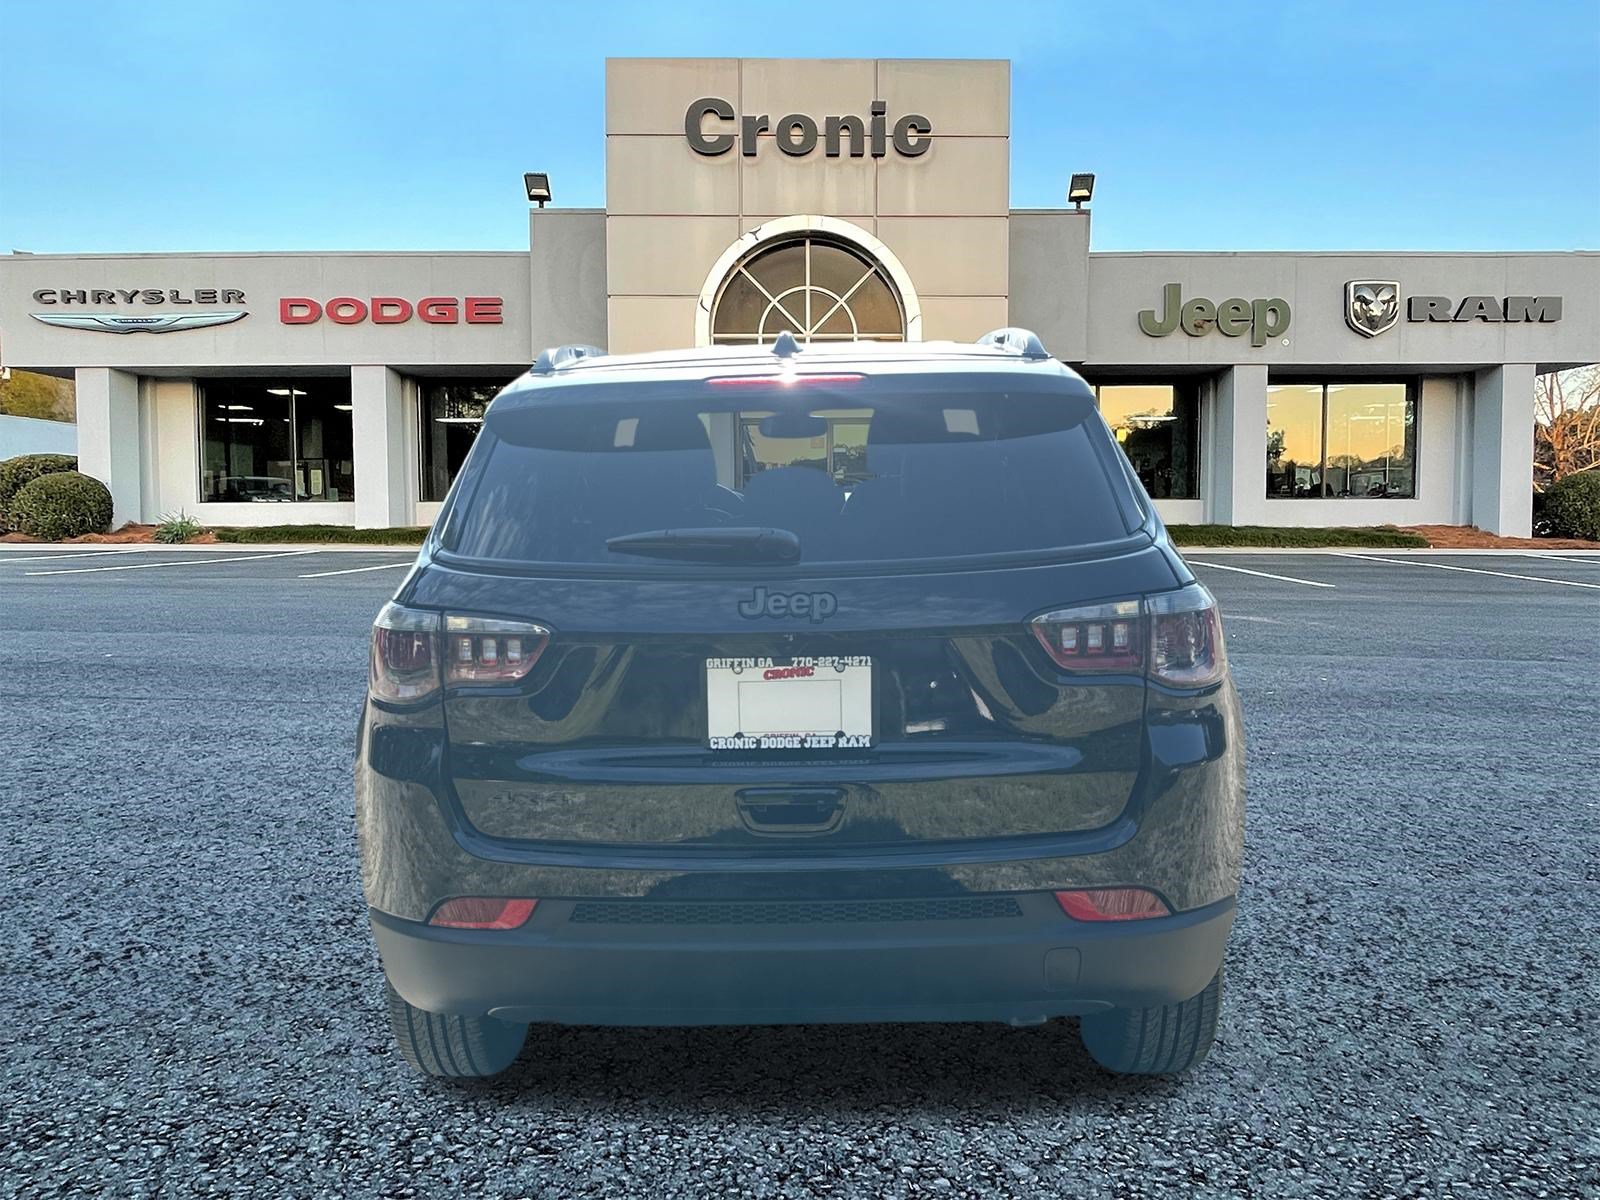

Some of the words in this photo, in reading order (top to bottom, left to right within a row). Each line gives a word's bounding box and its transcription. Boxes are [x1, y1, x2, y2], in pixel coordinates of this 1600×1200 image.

[685, 97, 932, 158] Cronic
[32, 289, 246, 304] CHRYSLER
[280, 296, 503, 325] DODGE
[1407, 295, 1563, 323] RAM
[1138, 283, 1291, 347] Jeep
[738, 586, 837, 624] Jeep
[706, 658, 755, 668] GRIFFIN
[757, 658, 774, 667] GA
[791, 656, 872, 666] 770-227-4271
[763, 666, 815, 680] CRONIC
[710, 737, 757, 749] CRONIC
[760, 737, 801, 748] DODGE
[803, 736, 836, 748] JEEP
[838, 736, 871, 748] RAM
